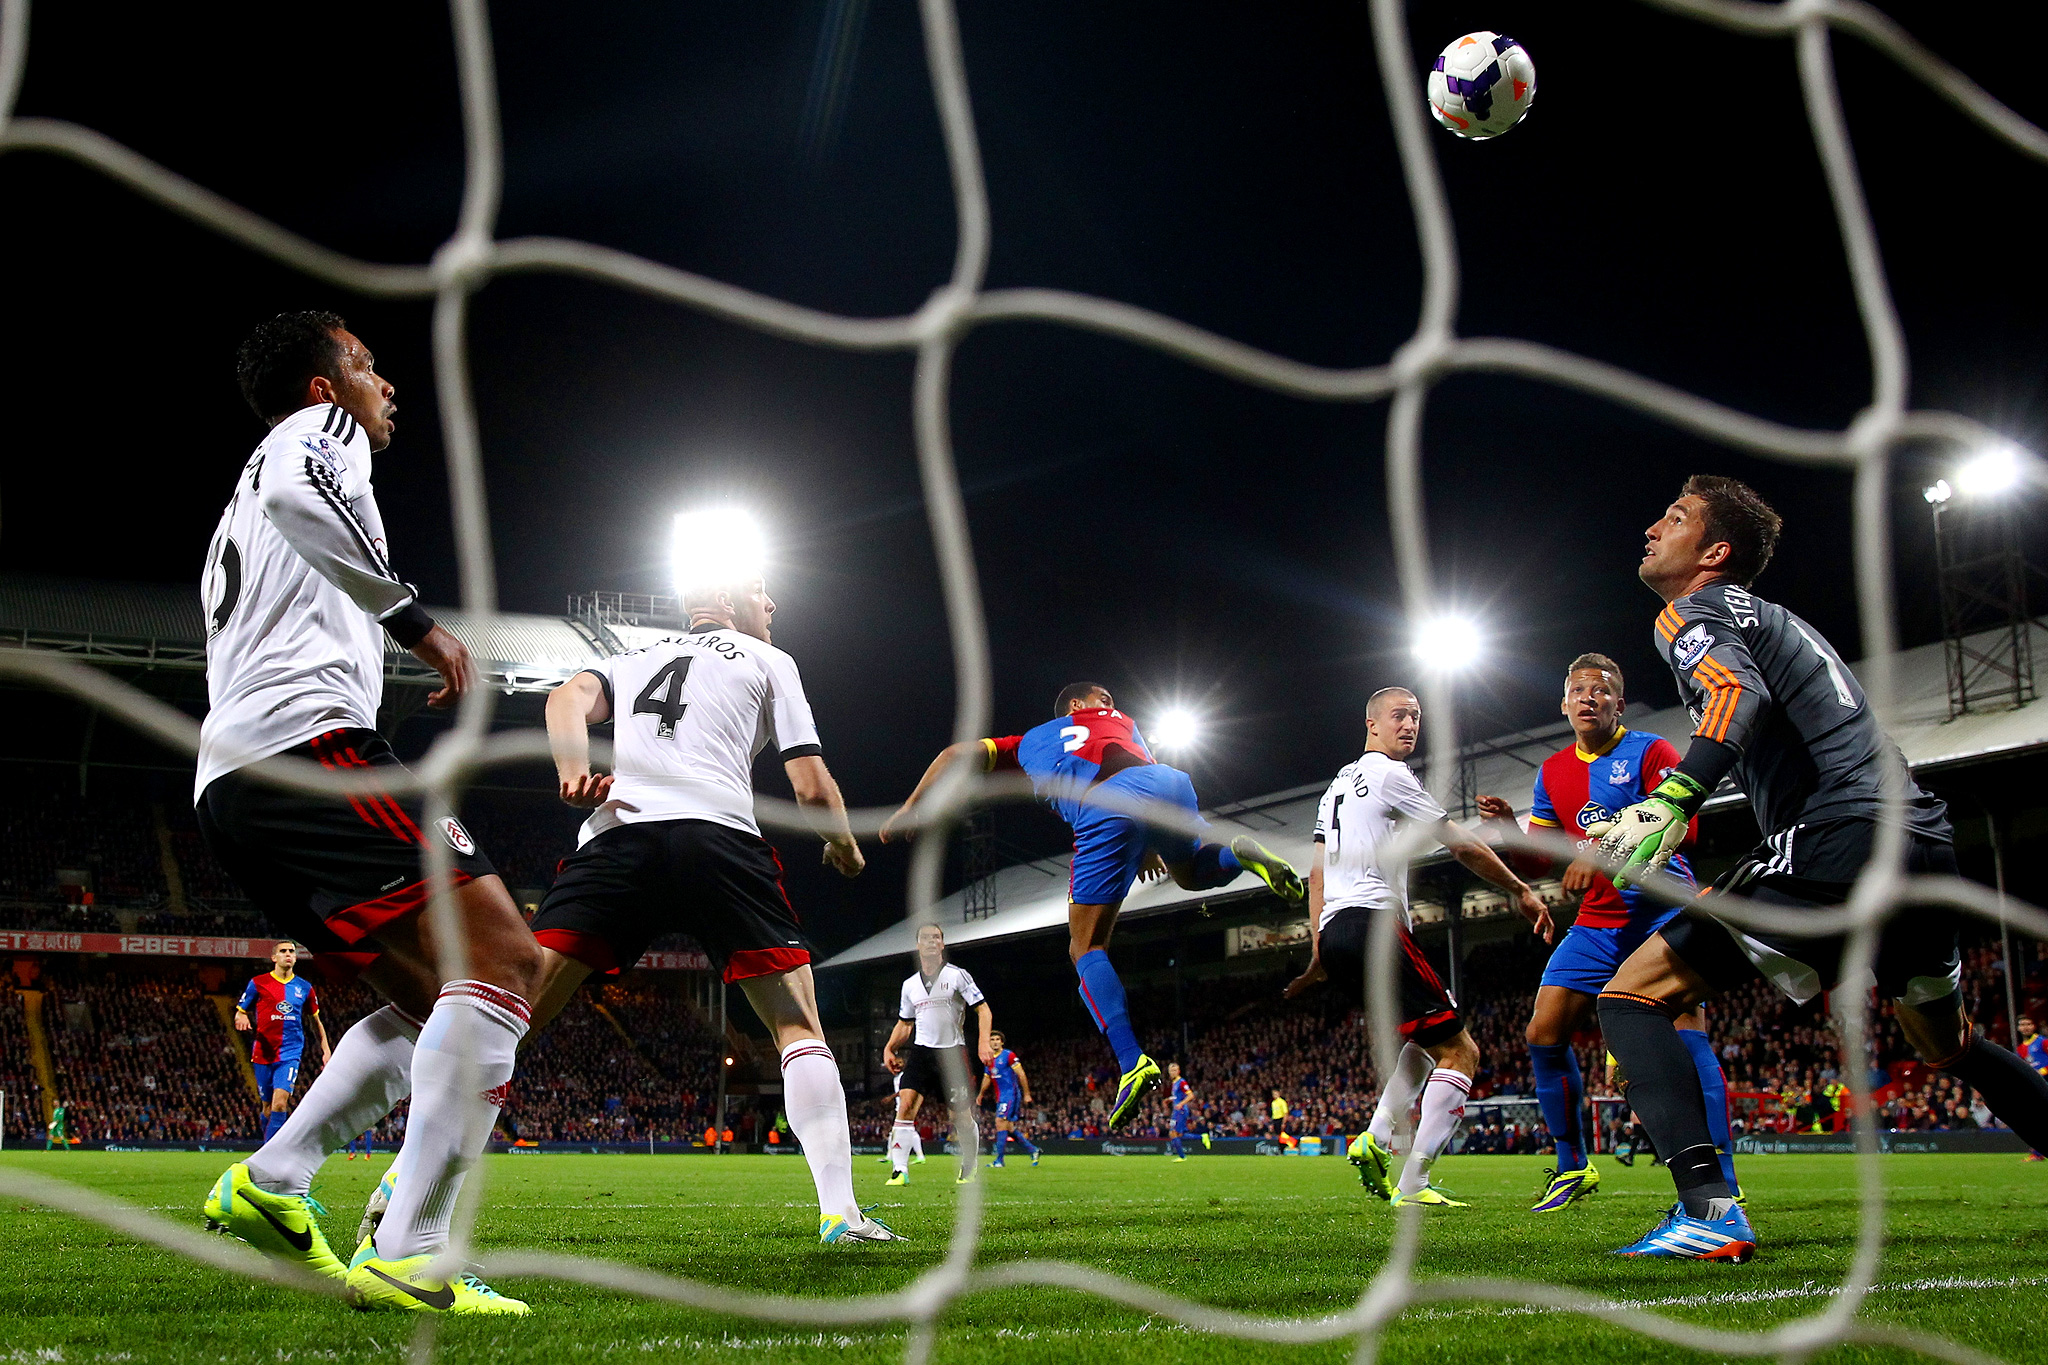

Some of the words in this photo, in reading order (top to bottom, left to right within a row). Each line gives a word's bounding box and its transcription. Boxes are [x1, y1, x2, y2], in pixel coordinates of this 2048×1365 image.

[632, 655, 696, 741] 4
[446, 821, 468, 847] FFC
[119, 937, 196, 954] 12BET
